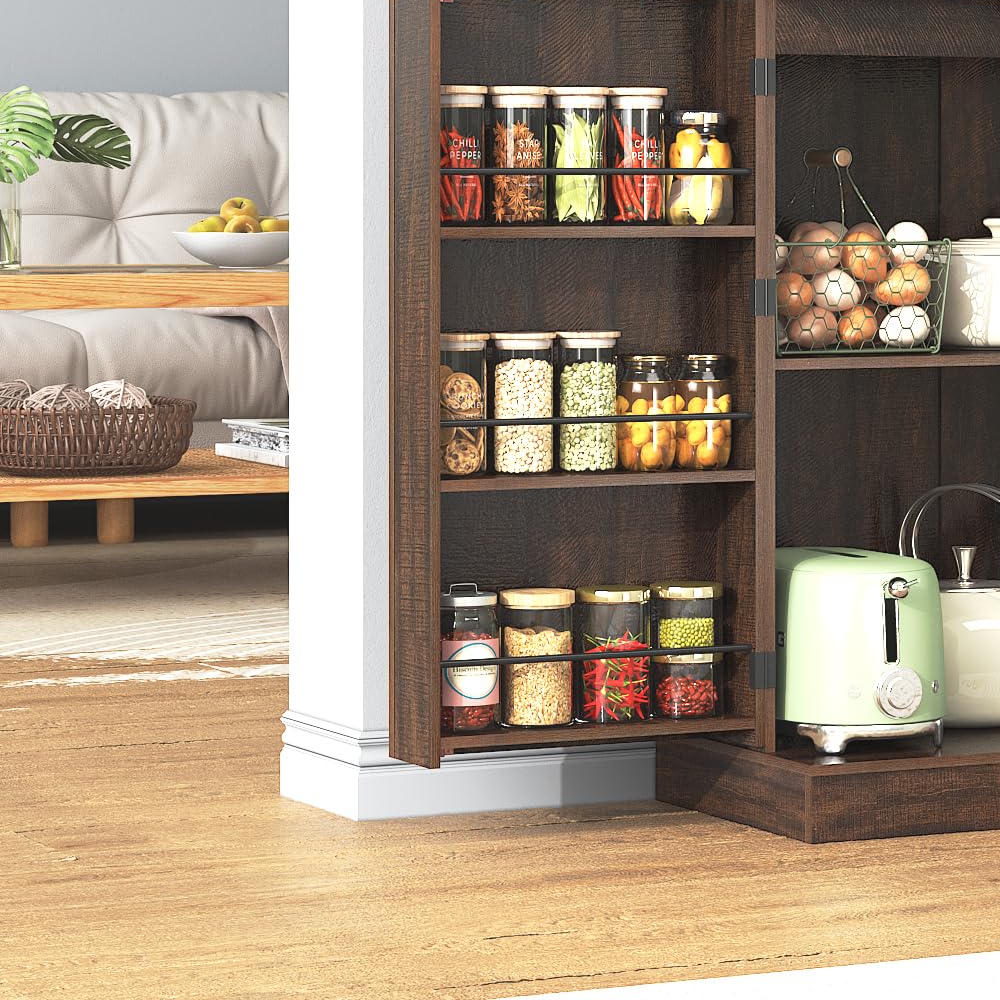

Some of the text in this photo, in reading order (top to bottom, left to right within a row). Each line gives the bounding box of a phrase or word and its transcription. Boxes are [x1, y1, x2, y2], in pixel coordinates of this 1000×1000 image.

[453, 139, 480, 148] CHILLI
[450, 151, 482, 160] PEPPER
[516, 151, 541, 160] ANISE
